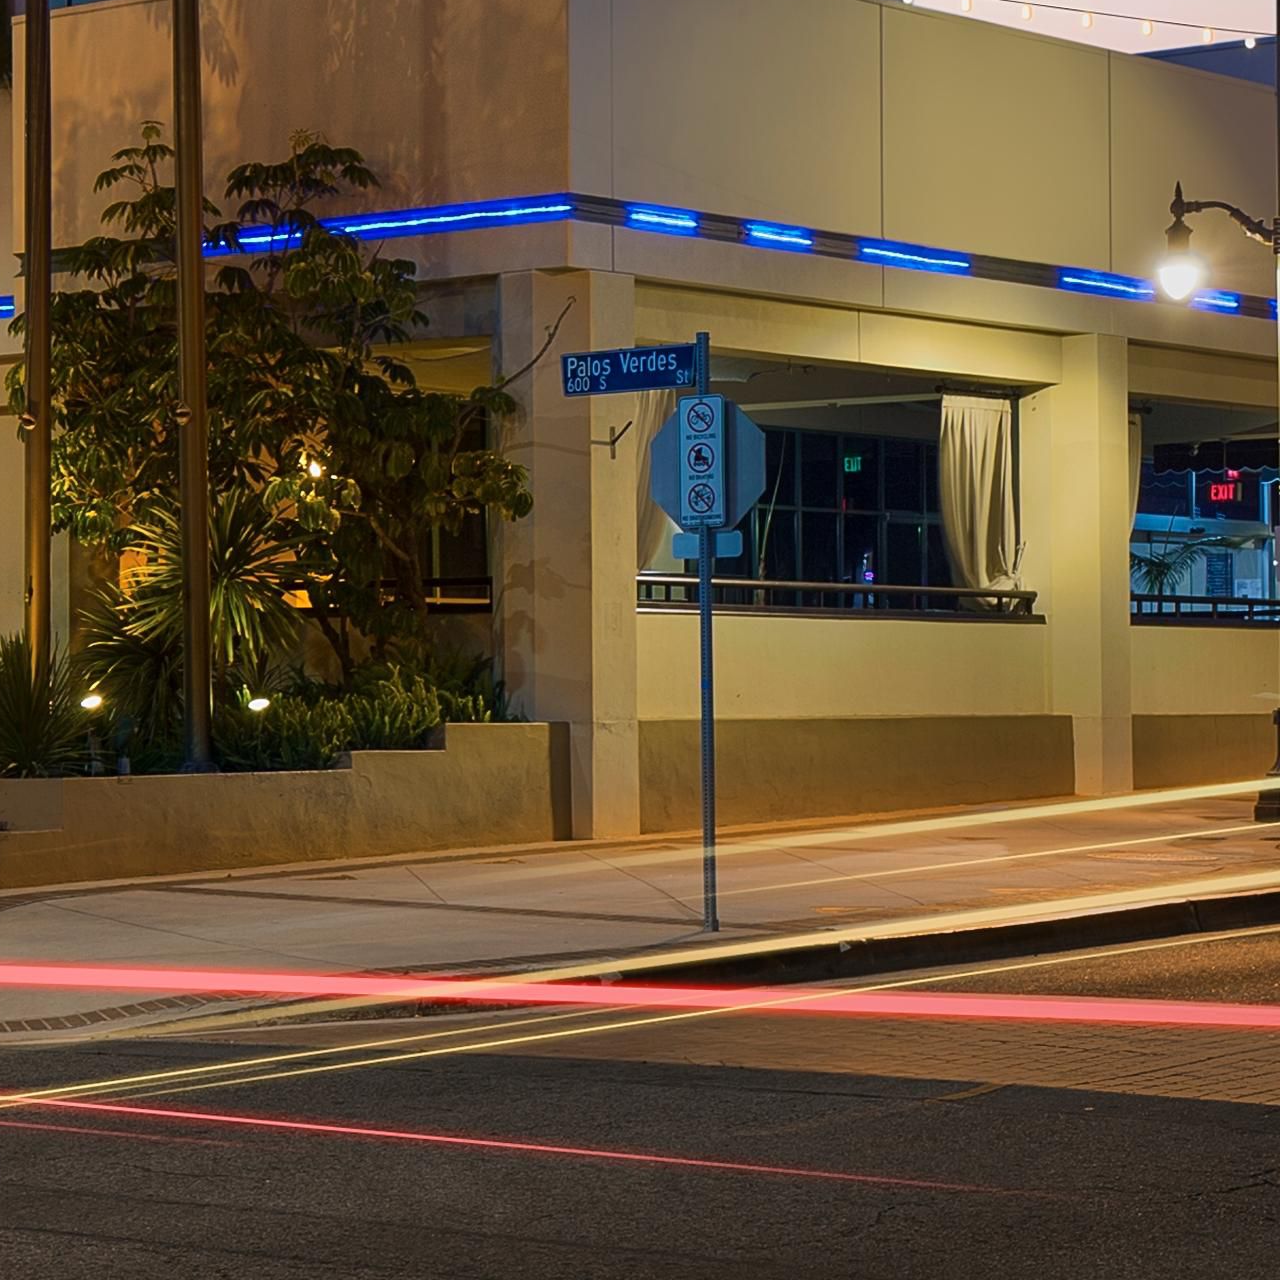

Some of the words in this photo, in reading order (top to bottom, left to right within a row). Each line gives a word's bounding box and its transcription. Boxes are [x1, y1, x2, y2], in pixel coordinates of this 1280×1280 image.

[567, 356, 611, 378] Palos
[620, 351, 677, 373] Verdes
[567, 376, 590, 392] 600
[600, 376, 607, 390] S
[676, 369, 689, 384] St
[844, 456, 862, 472] EXIT
[1210, 483, 1235, 501] EXIT
